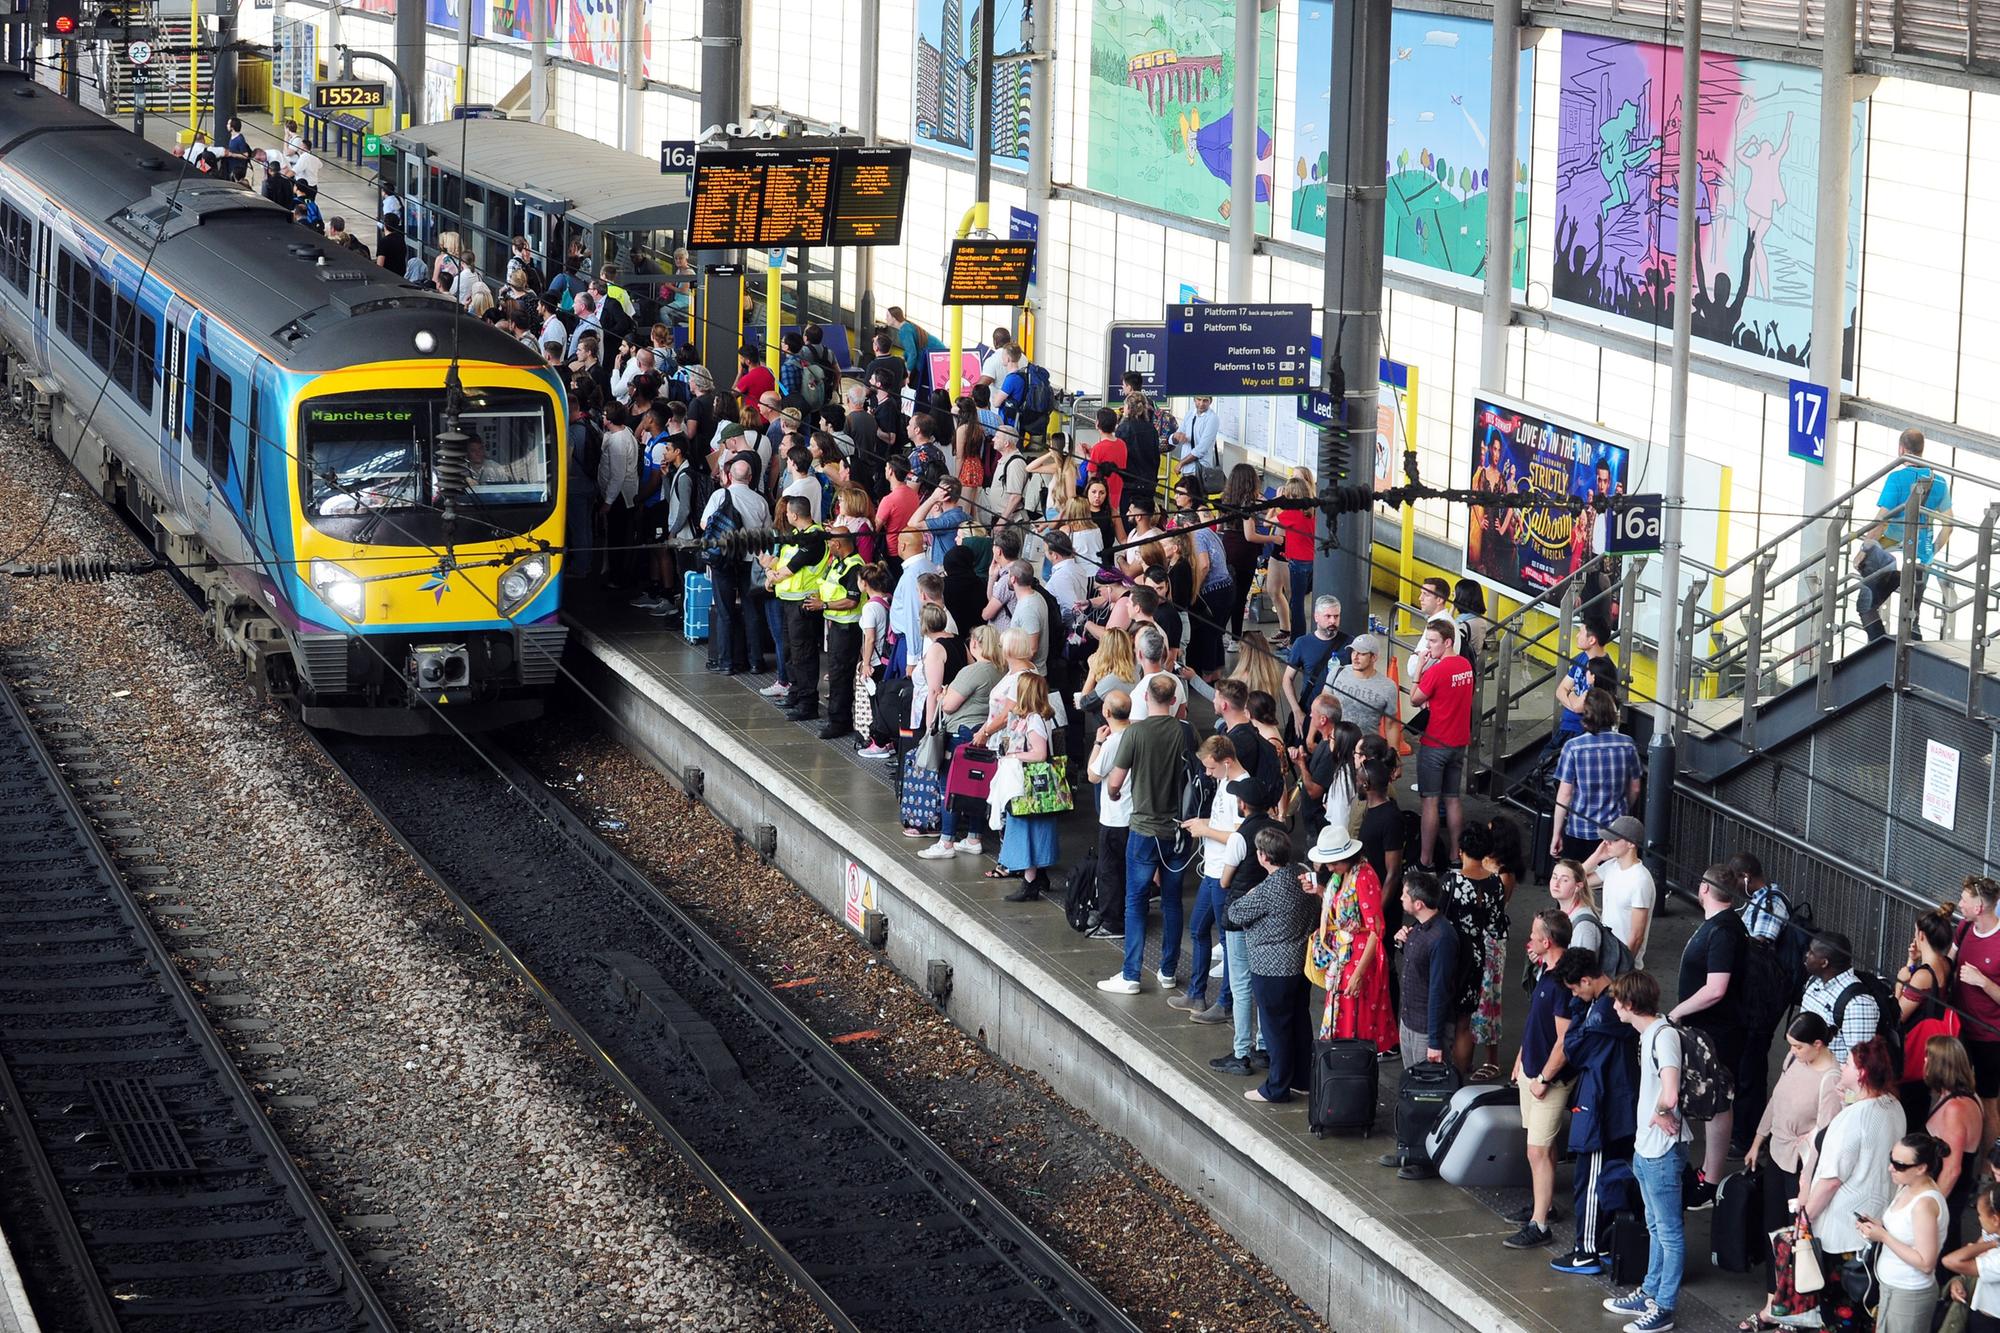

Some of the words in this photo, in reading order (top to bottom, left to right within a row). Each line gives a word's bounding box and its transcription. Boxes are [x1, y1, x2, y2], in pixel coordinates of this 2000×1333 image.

[134, 46, 147, 58] 25
[663, 147, 694, 166] 16a
[1228, 347, 1260, 355] Platform
[1262, 347, 1276, 355] 16b
[1242, 378, 1259, 386] Way
[1314, 396, 1333, 419] Leed
[1794, 391, 1821, 435] 17
[1516, 423, 1538, 448] LOVE
[1538, 428, 1547, 451] IS
[1549, 431, 1560, 454] IN
[1560, 435, 1576, 460] THE
[1576, 440, 1592, 465] AIR
[1529, 462, 1569, 495] STRICTLY
[1615, 506, 1660, 540] 16a
[1531, 539, 1540, 553] THE
[1542, 547, 1565, 560] MUSICAL
